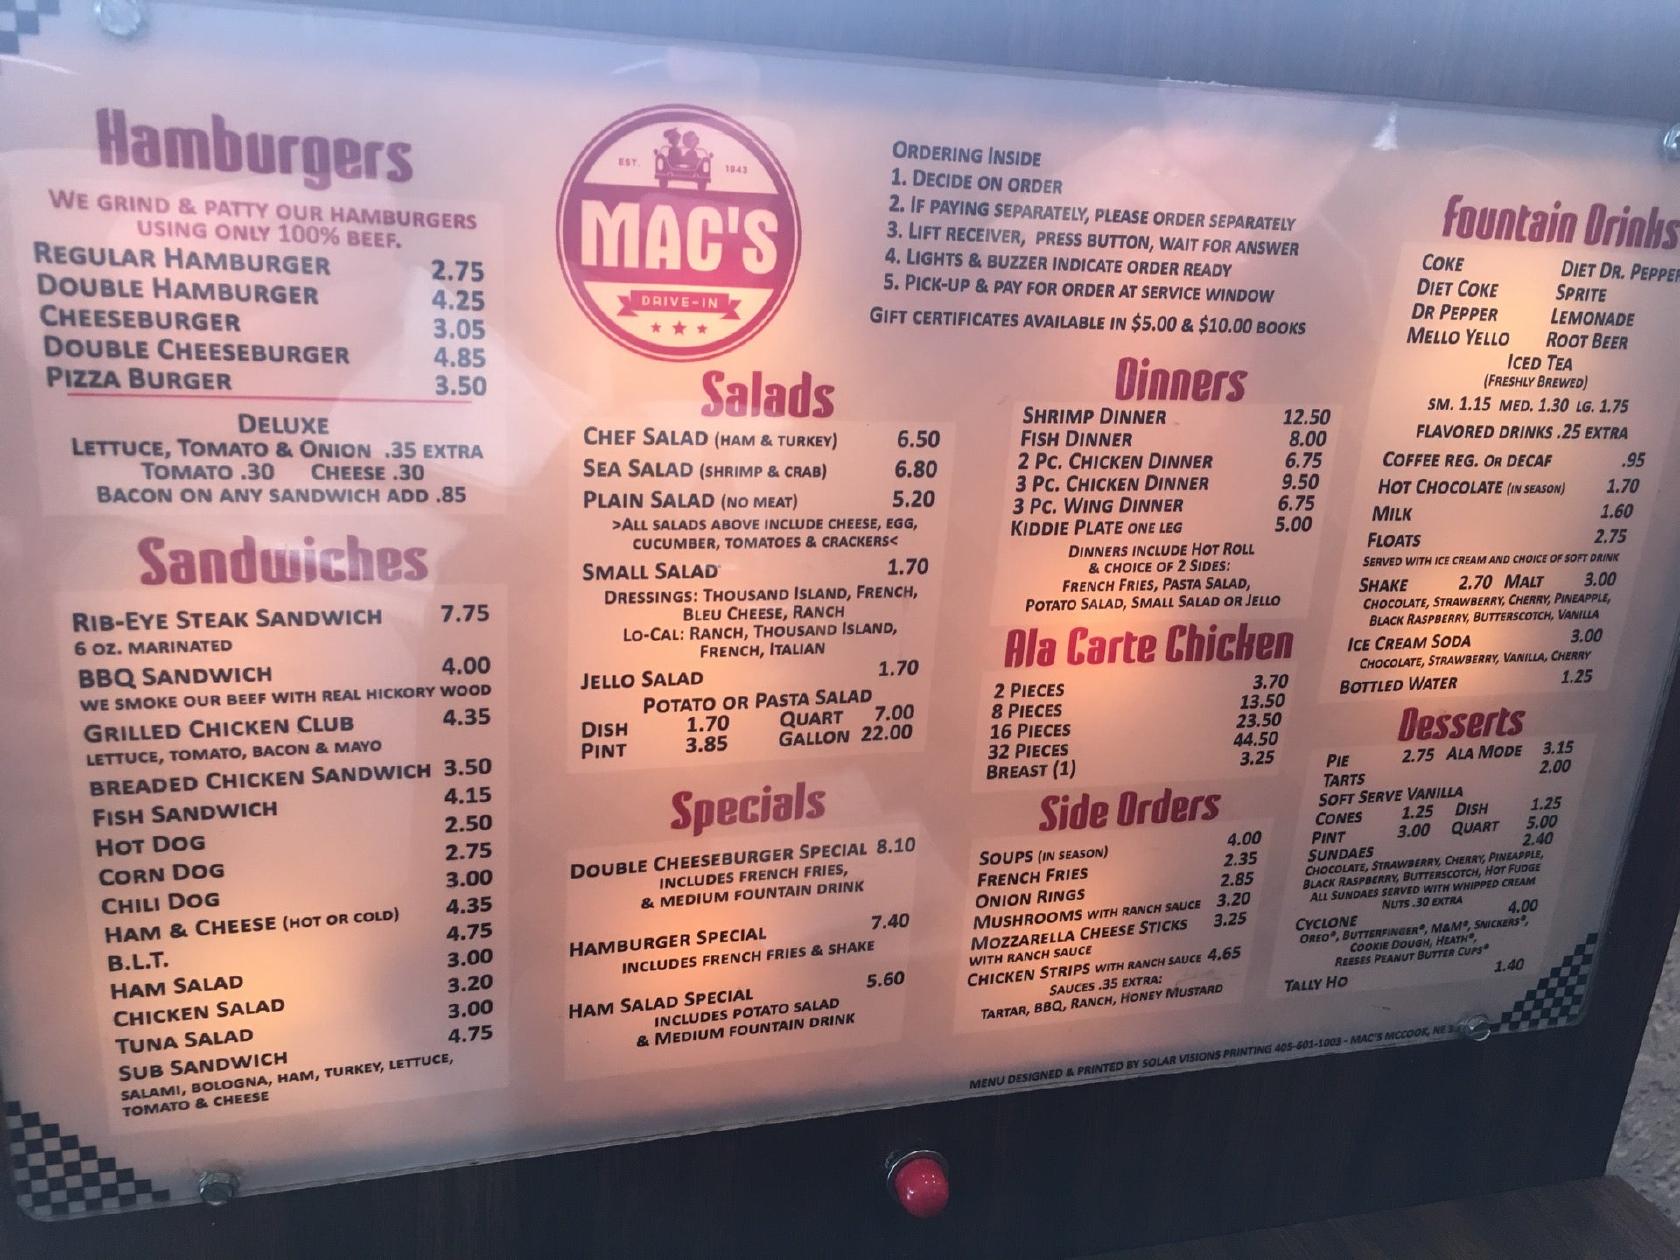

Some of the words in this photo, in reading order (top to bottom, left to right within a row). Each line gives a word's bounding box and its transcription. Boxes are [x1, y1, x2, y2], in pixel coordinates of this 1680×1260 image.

[96, 108, 412, 190] Hamburgers
[892, 140, 982, 164] ORDERING
[988, 146, 1042, 167] INSIDE
[892, 168, 906, 186] 1.
[913, 169, 972, 190] DECIDE
[978, 176, 1002, 192] ON
[1008, 178, 1062, 194] ORDER
[48, 190, 88, 210] WE
[98, 194, 170, 213] GRIND
[179, 198, 196, 214] &
[206, 200, 268, 218] PATTY
[276, 204, 322, 221] OUR
[331, 207, 476, 230] HAMBURGERS
[1583, 202, 1680, 250] Drinks
[138, 220, 206, 238] USING
[216, 224, 270, 241] ONLY
[279, 224, 340, 244] 100%
[348, 231, 401, 248] BEEF.
[580, 200, 779, 275] MAC'S
[34, 242, 156, 268] REGULAR
[164, 248, 330, 276] HAMBURGER
[432, 260, 484, 282] 2.75
[885, 248, 900, 264] 4.
[906, 248, 963, 268] LIGHTS
[968, 252, 982, 268] &
[987, 255, 1047, 270] BUZZER
[1052, 256, 1123, 274] INDICATE
[1127, 260, 1179, 276] ORDER
[1183, 262, 1232, 277] READY
[1422, 254, 1464, 272] COKE
[37, 273, 144, 298] DOUBLE
[152, 277, 318, 304] HAMBURGER
[432, 290, 484, 312] 4.25
[641, 295, 718, 309] DRIVE-IN
[1556, 284, 1607, 302] SPRITE
[40, 304, 240, 332] CHEESEBURGER
[434, 318, 485, 340] 3.05
[1550, 308, 1635, 326] LEMONADE
[44, 334, 149, 359] DOUBLE
[158, 338, 350, 364] CHEESEBURGER
[434, 347, 486, 368] 4.85
[46, 366, 122, 388] PIZZA
[128, 368, 232, 390] BURGER
[436, 375, 486, 396] 3.50
[702, 370, 835, 418] Salads
[1115, 356, 1248, 402] Dinners
[1022, 406, 1094, 424] SHRIMP
[1100, 408, 1166, 424] DINNER
[1283, 409, 1331, 426] 12.50
[1428, 398, 1454, 410] SM.
[1459, 396, 1492, 411] 1.15
[1499, 400, 1533, 412] MED.
[1538, 398, 1570, 412] 1.30
[1576, 400, 1594, 413] LG.
[1600, 398, 1629, 414] 1.75
[238, 414, 329, 434] DELUXE
[584, 426, 636, 445] CHEF
[643, 427, 708, 446] SALAD
[714, 432, 755, 450] (HAM
[760, 434, 773, 446] &
[778, 432, 837, 450] TURKEY)
[898, 430, 940, 448] 6.50
[1383, 451, 1440, 467] COFFEE
[1444, 454, 1478, 468] REG.
[1484, 454, 1502, 468] OR
[1506, 454, 1552, 468] DECAF
[1622, 452, 1646, 468] .95
[1012, 498, 1024, 514] 3
[1030, 498, 1056, 514] PC.
[1064, 497, 1114, 514] WING
[1118, 496, 1184, 514] DINNER
[1278, 494, 1315, 512] 6.75
[1372, 506, 1412, 522] MILK
[1600, 504, 1634, 519] 1.60
[633, 538, 720, 551] CUCUMBER,
[724, 536, 801, 549] TOMATOES
[806, 536, 816, 548] &
[822, 536, 898, 548] CRACKERS<
[138, 535, 428, 586] Sandwiches
[582, 563, 648, 581] SMALL
[655, 562, 718, 580] SALAD
[888, 558, 928, 576] 1.70
[72, 612, 168, 632] RIB-EYE
[176, 610, 248, 630] STEAK
[256, 608, 382, 627] SANDWICH
[441, 604, 490, 622] 7.75
[74, 641, 87, 656] 6
[92, 642, 122, 656] OZ.
[128, 640, 232, 654] MARINATED
[1004, 628, 1056, 668] Ala
[1066, 626, 1157, 666] Carte
[1165, 622, 1294, 662] Chicken
[78, 668, 136, 690] BBQ
[142, 666, 272, 686] SANDWICH
[442, 656, 491, 676] 4.00
[994, 683, 1004, 699] 2
[1010, 682, 1064, 698] PIECES
[1252, 674, 1289, 690] 3.70
[84, 724, 181, 744] GRILLED
[189, 718, 290, 738] CHICKEN
[297, 715, 354, 734] CLUB
[443, 708, 491, 726] 4.35
[1397, 706, 1526, 742] Desserts
[1326, 754, 1350, 768] PIE
[1402, 748, 1435, 764] 2.75
[1446, 746, 1474, 760] ALA
[1478, 744, 1523, 759] MODE
[1542, 740, 1574, 755] 3.15
[670, 782, 826, 837] Specials
[1038, 793, 1109, 831] Side
[1116, 788, 1222, 826] Orders
[96, 838, 144, 857] HOT
[152, 836, 206, 853] DOG
[445, 814, 492, 834] 2.50
[1308, 846, 1374, 863] SUNDAES
[1522, 832, 1554, 846] 2.40
[570, 860, 648, 879] DOUBLE
[654, 848, 794, 872] CHEESEBURGER
[799, 843, 868, 860] SPECIAL
[876, 837, 916, 854] 8.10
[641, 898, 654, 909] &
[660, 891, 728, 908] MEDIUM
[734, 884, 812, 901] FOUNTAIN
[816, 880, 864, 894] DRINK
[976, 892, 1032, 908] ONION
[1036, 888, 1085, 904] RINGS
[1220, 872, 1254, 888] 2.85
[108, 951, 168, 972] B.L.T.
[446, 922, 492, 942] 4.75
[570, 934, 690, 957] HAMBURGER
[696, 927, 766, 945] SPECIAL
[872, 913, 910, 930] 7.40
[969, 1078, 1006, 1089] MENU
[1008, 1069, 1063, 1084] DESIGNED
[1066, 1068, 1074, 1076] &
[1077, 1062, 1124, 1075] PRINTED
[1126, 1059, 1140, 1070] BY
[1142, 1056, 1176, 1067] SOLAR
[1179, 1050, 1222, 1063] VISIONS
[1223, 1044, 1272, 1059] PRINTING
[1350, 1032, 1383, 1044] MAC'S
[120, 1085, 186, 1101] SALAMI,
[192, 1076, 272, 1094] BOLOGNA,
[278, 1070, 320, 1084] HAM,
[324, 1062, 384, 1078] TURKEY,
[389, 1054, 454, 1070] LETTUCE,
